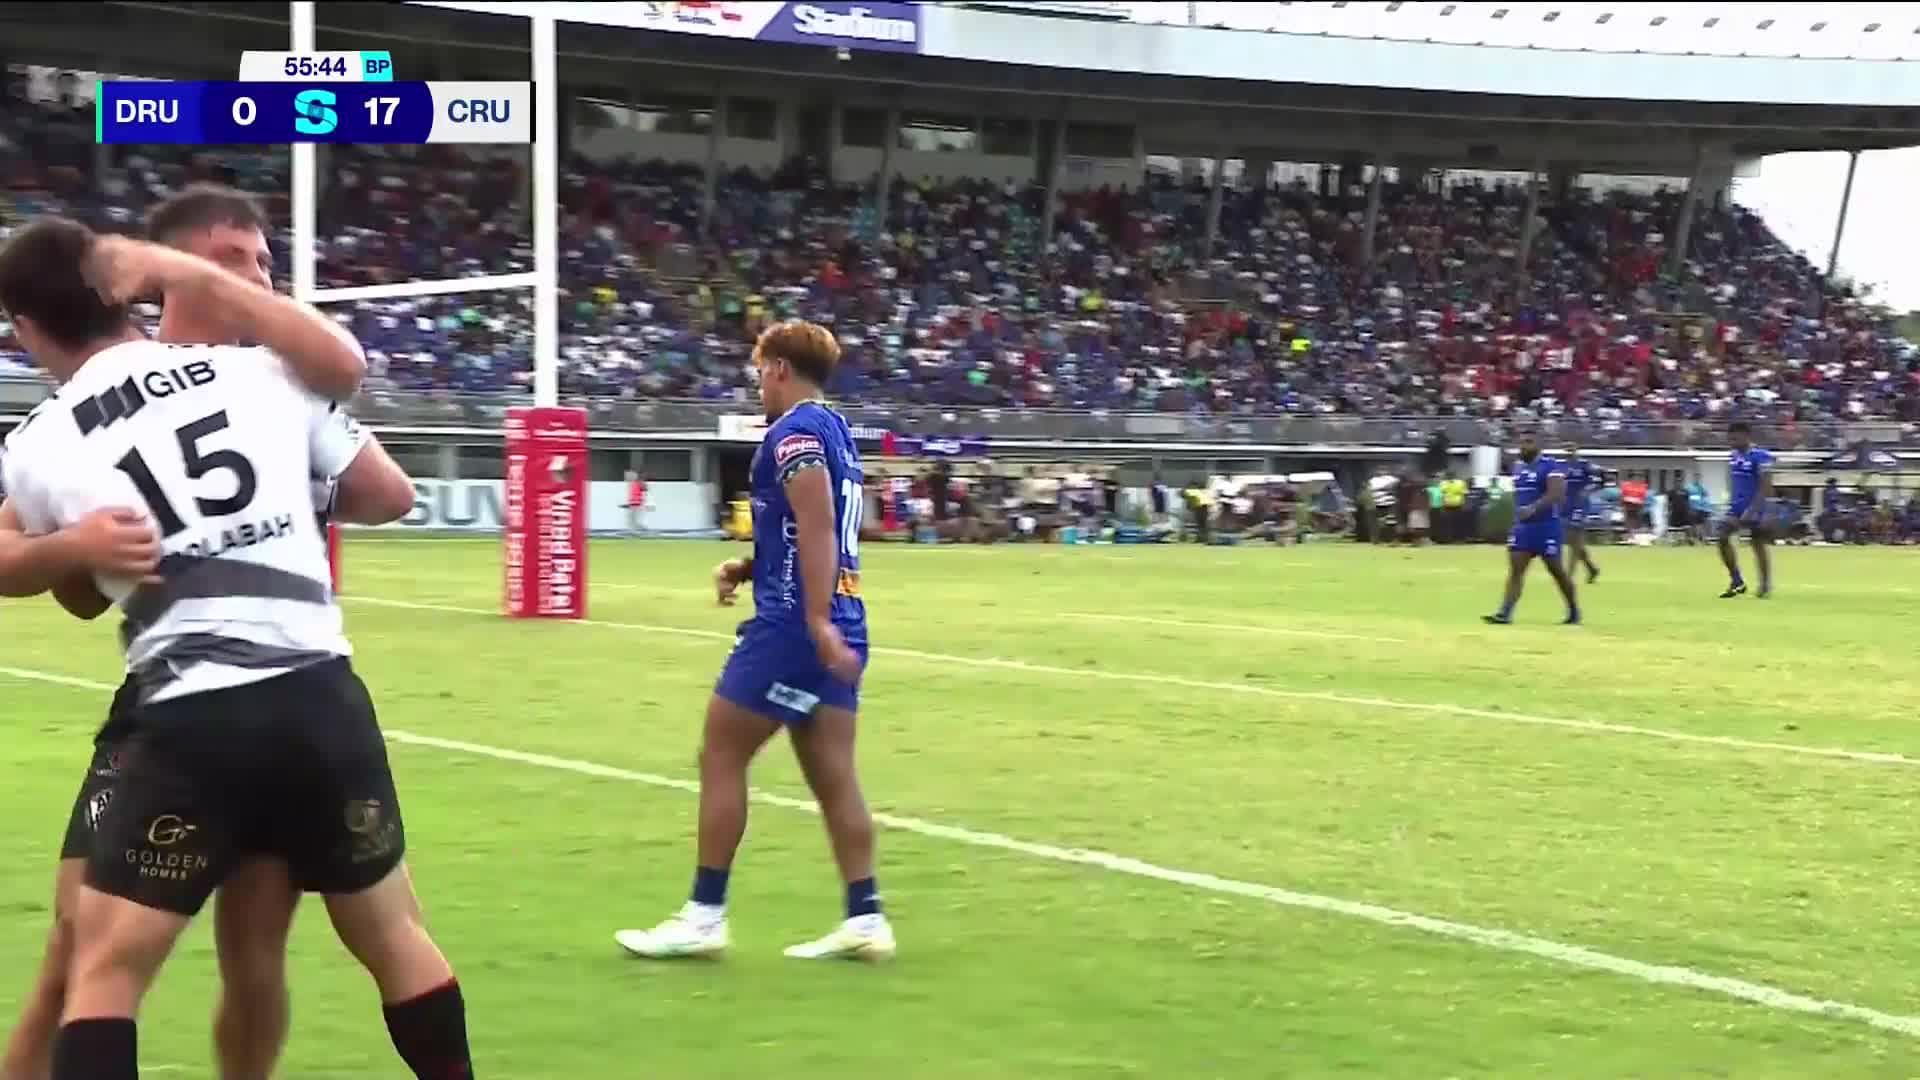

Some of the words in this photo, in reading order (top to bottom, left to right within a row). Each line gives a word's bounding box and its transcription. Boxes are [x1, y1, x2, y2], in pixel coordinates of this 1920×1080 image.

[793, 4, 915, 42] Stadium
[143, 359, 216, 398] GIB
[113, 409, 257, 538] 15
[550, 490, 577, 554] Vinod
[841, 478, 863, 557] 10
[550, 558, 577, 614] Patel
[125, 848, 208, 870] GOLDEN
